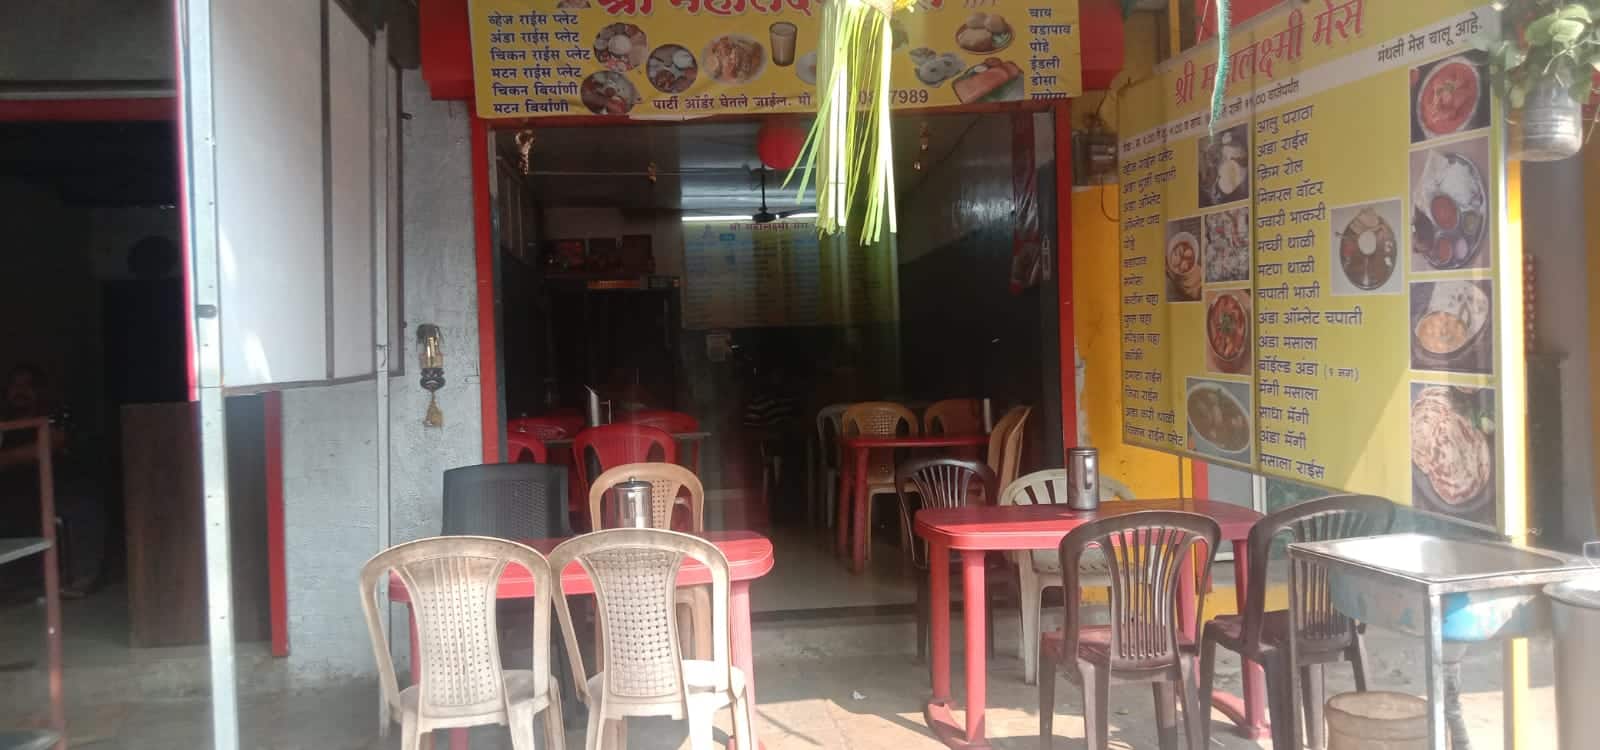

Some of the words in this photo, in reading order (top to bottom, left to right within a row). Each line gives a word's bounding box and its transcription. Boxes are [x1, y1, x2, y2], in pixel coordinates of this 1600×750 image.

[519, 10, 547, 26] राईस
[552, 10, 578, 25] प्लेट
[1028, 8, 1052, 18] चाय
[490, 29, 515, 43] अंडा
[520, 28, 549, 44] राईस
[554, 27, 579, 42] प्लेट
[1028, 24, 1072, 35] वडापाव
[1029, 38, 1049, 52] पोहे
[1408, 34, 1424, 53] मेस
[1429, 25, 1454, 46] चालू
[490, 46, 526, 61] चिकन
[532, 45, 560, 61] राईस
[566, 45, 590, 60] प्लेट
[1176, 60, 1195, 104] श्री
[1312, 0, 1363, 45] मेस
[491, 68, 516, 78] मटन
[523, 64, 550, 80] राईस
[556, 64, 581, 78] प्लेट
[1029, 71, 1057, 86] डोसा
[492, 82, 528, 96] चिकन
[493, 102, 519, 113] मटन
[653, 94, 678, 110] पार्टी
[1280, 130, 1308, 151] राईस
[1283, 157, 1303, 176] रोल
[1296, 178, 1324, 198] वॉटर
[1290, 202, 1326, 224] भाकरी
[1288, 230, 1315, 249] थाळी
[1288, 256, 1315, 274] थाळी
[1258, 282, 1289, 300] चपाती
[1294, 280, 1320, 299] भाजी
[1259, 307, 1279, 324] अंडा
[1283, 306, 1320, 325] ऑम्लेट
[1325, 306, 1362, 326] चपाती
[1259, 331, 1279, 348] अंडा
[1283, 336, 1318, 351] मसाला
[1296, 358, 1318, 376] अंडा
[1284, 385, 1319, 401] मसाला
[1260, 426, 1280, 445] अंडा
[1260, 453, 1292, 473] मसाला
[1296, 458, 1325, 480] राईस
